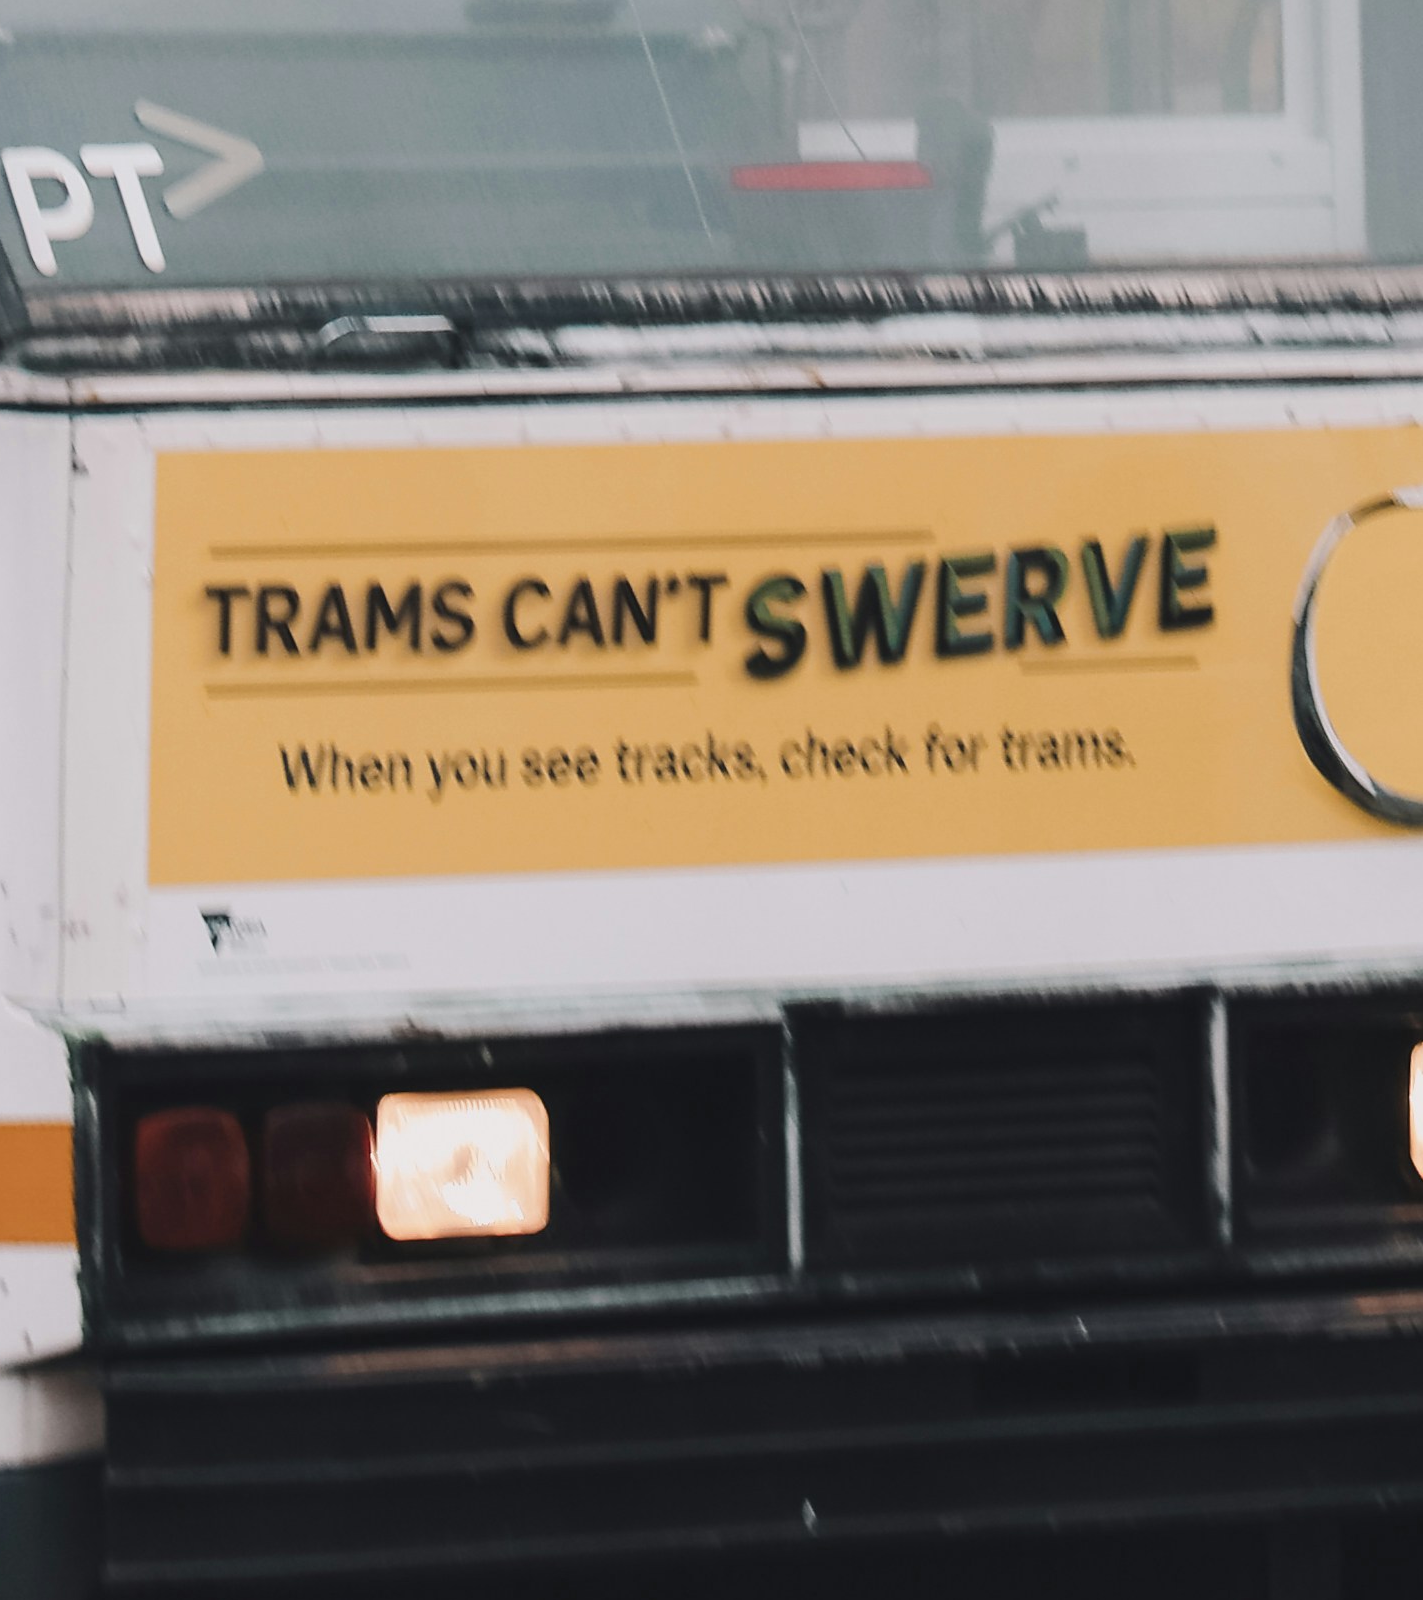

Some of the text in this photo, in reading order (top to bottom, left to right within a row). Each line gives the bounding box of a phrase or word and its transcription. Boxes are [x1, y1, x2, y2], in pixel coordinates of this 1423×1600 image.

[1, 141, 166, 278] PT
[203, 522, 1218, 682] TRAMS CAN'T SWERVE
[278, 721, 1137, 804] When you see tracks, check for trams.
